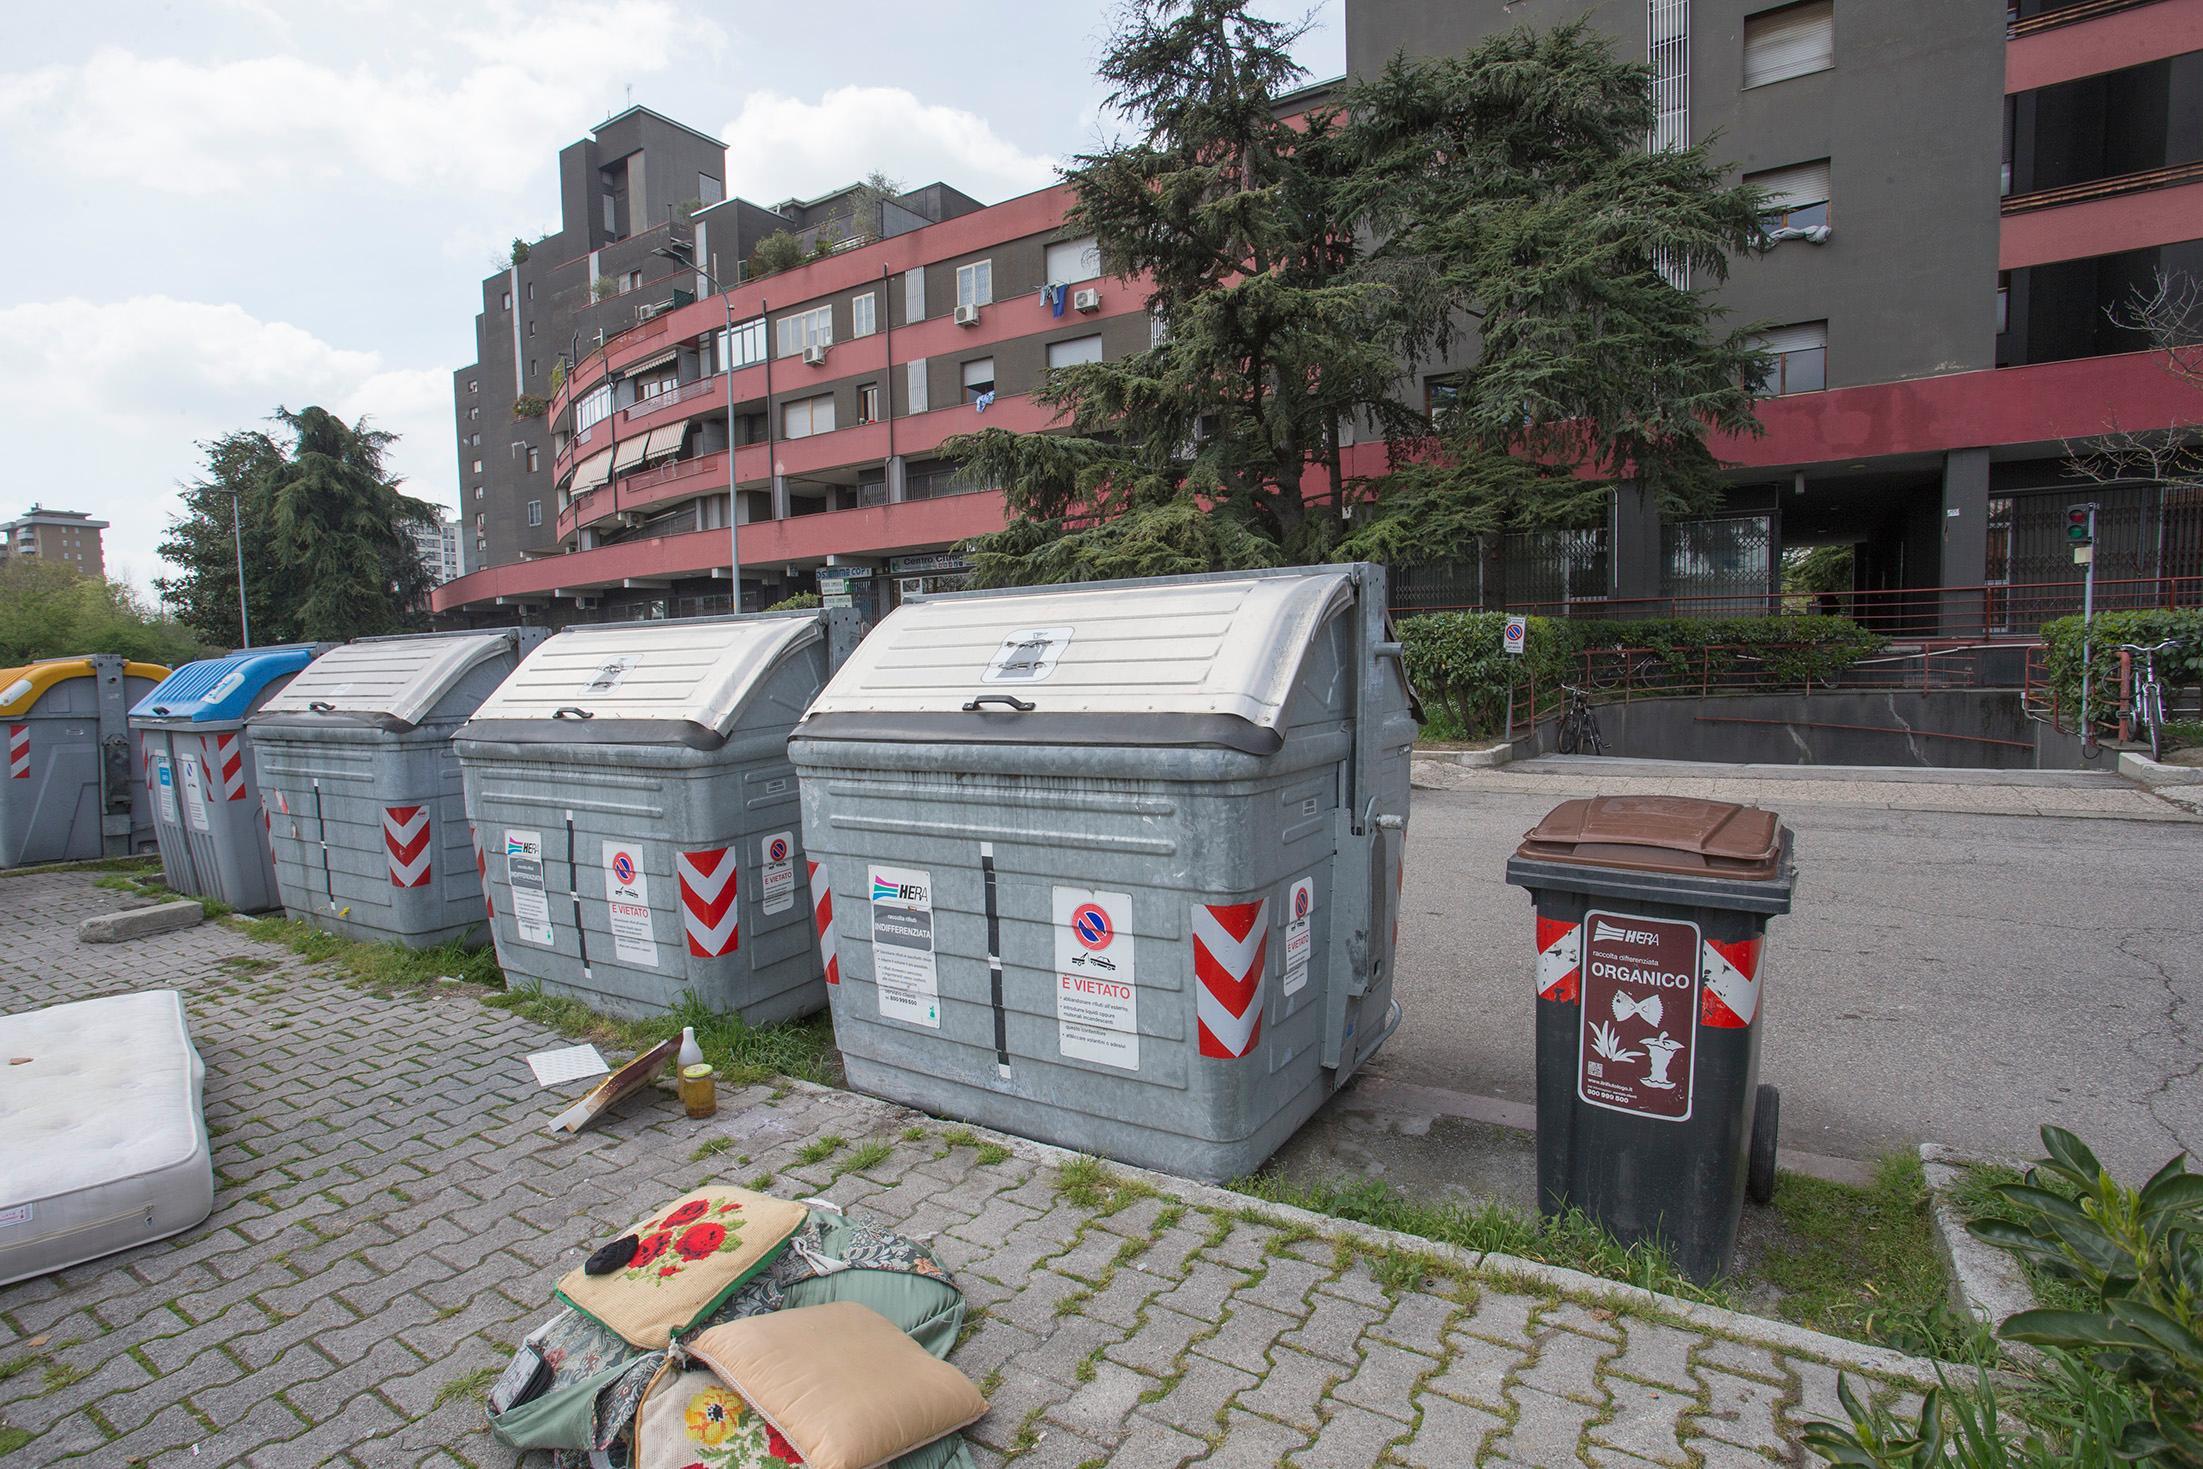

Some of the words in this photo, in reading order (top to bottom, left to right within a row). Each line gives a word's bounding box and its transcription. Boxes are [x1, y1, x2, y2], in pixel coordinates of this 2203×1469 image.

[904, 556, 933, 565] Centro
[935, 553, 963, 563] Clinic
[899, 884, 928, 902] HERA
[619, 905, 648, 918] VIETATO
[875, 922, 932, 939] INDIFFERENZIATA
[1625, 930, 1659, 946] HERA
[1592, 950, 1618, 960] raccolta
[1619, 955, 1659, 966] differenziata
[1591, 962, 1690, 989] ORGANICO
[1073, 979, 1131, 1000] VIETATO
